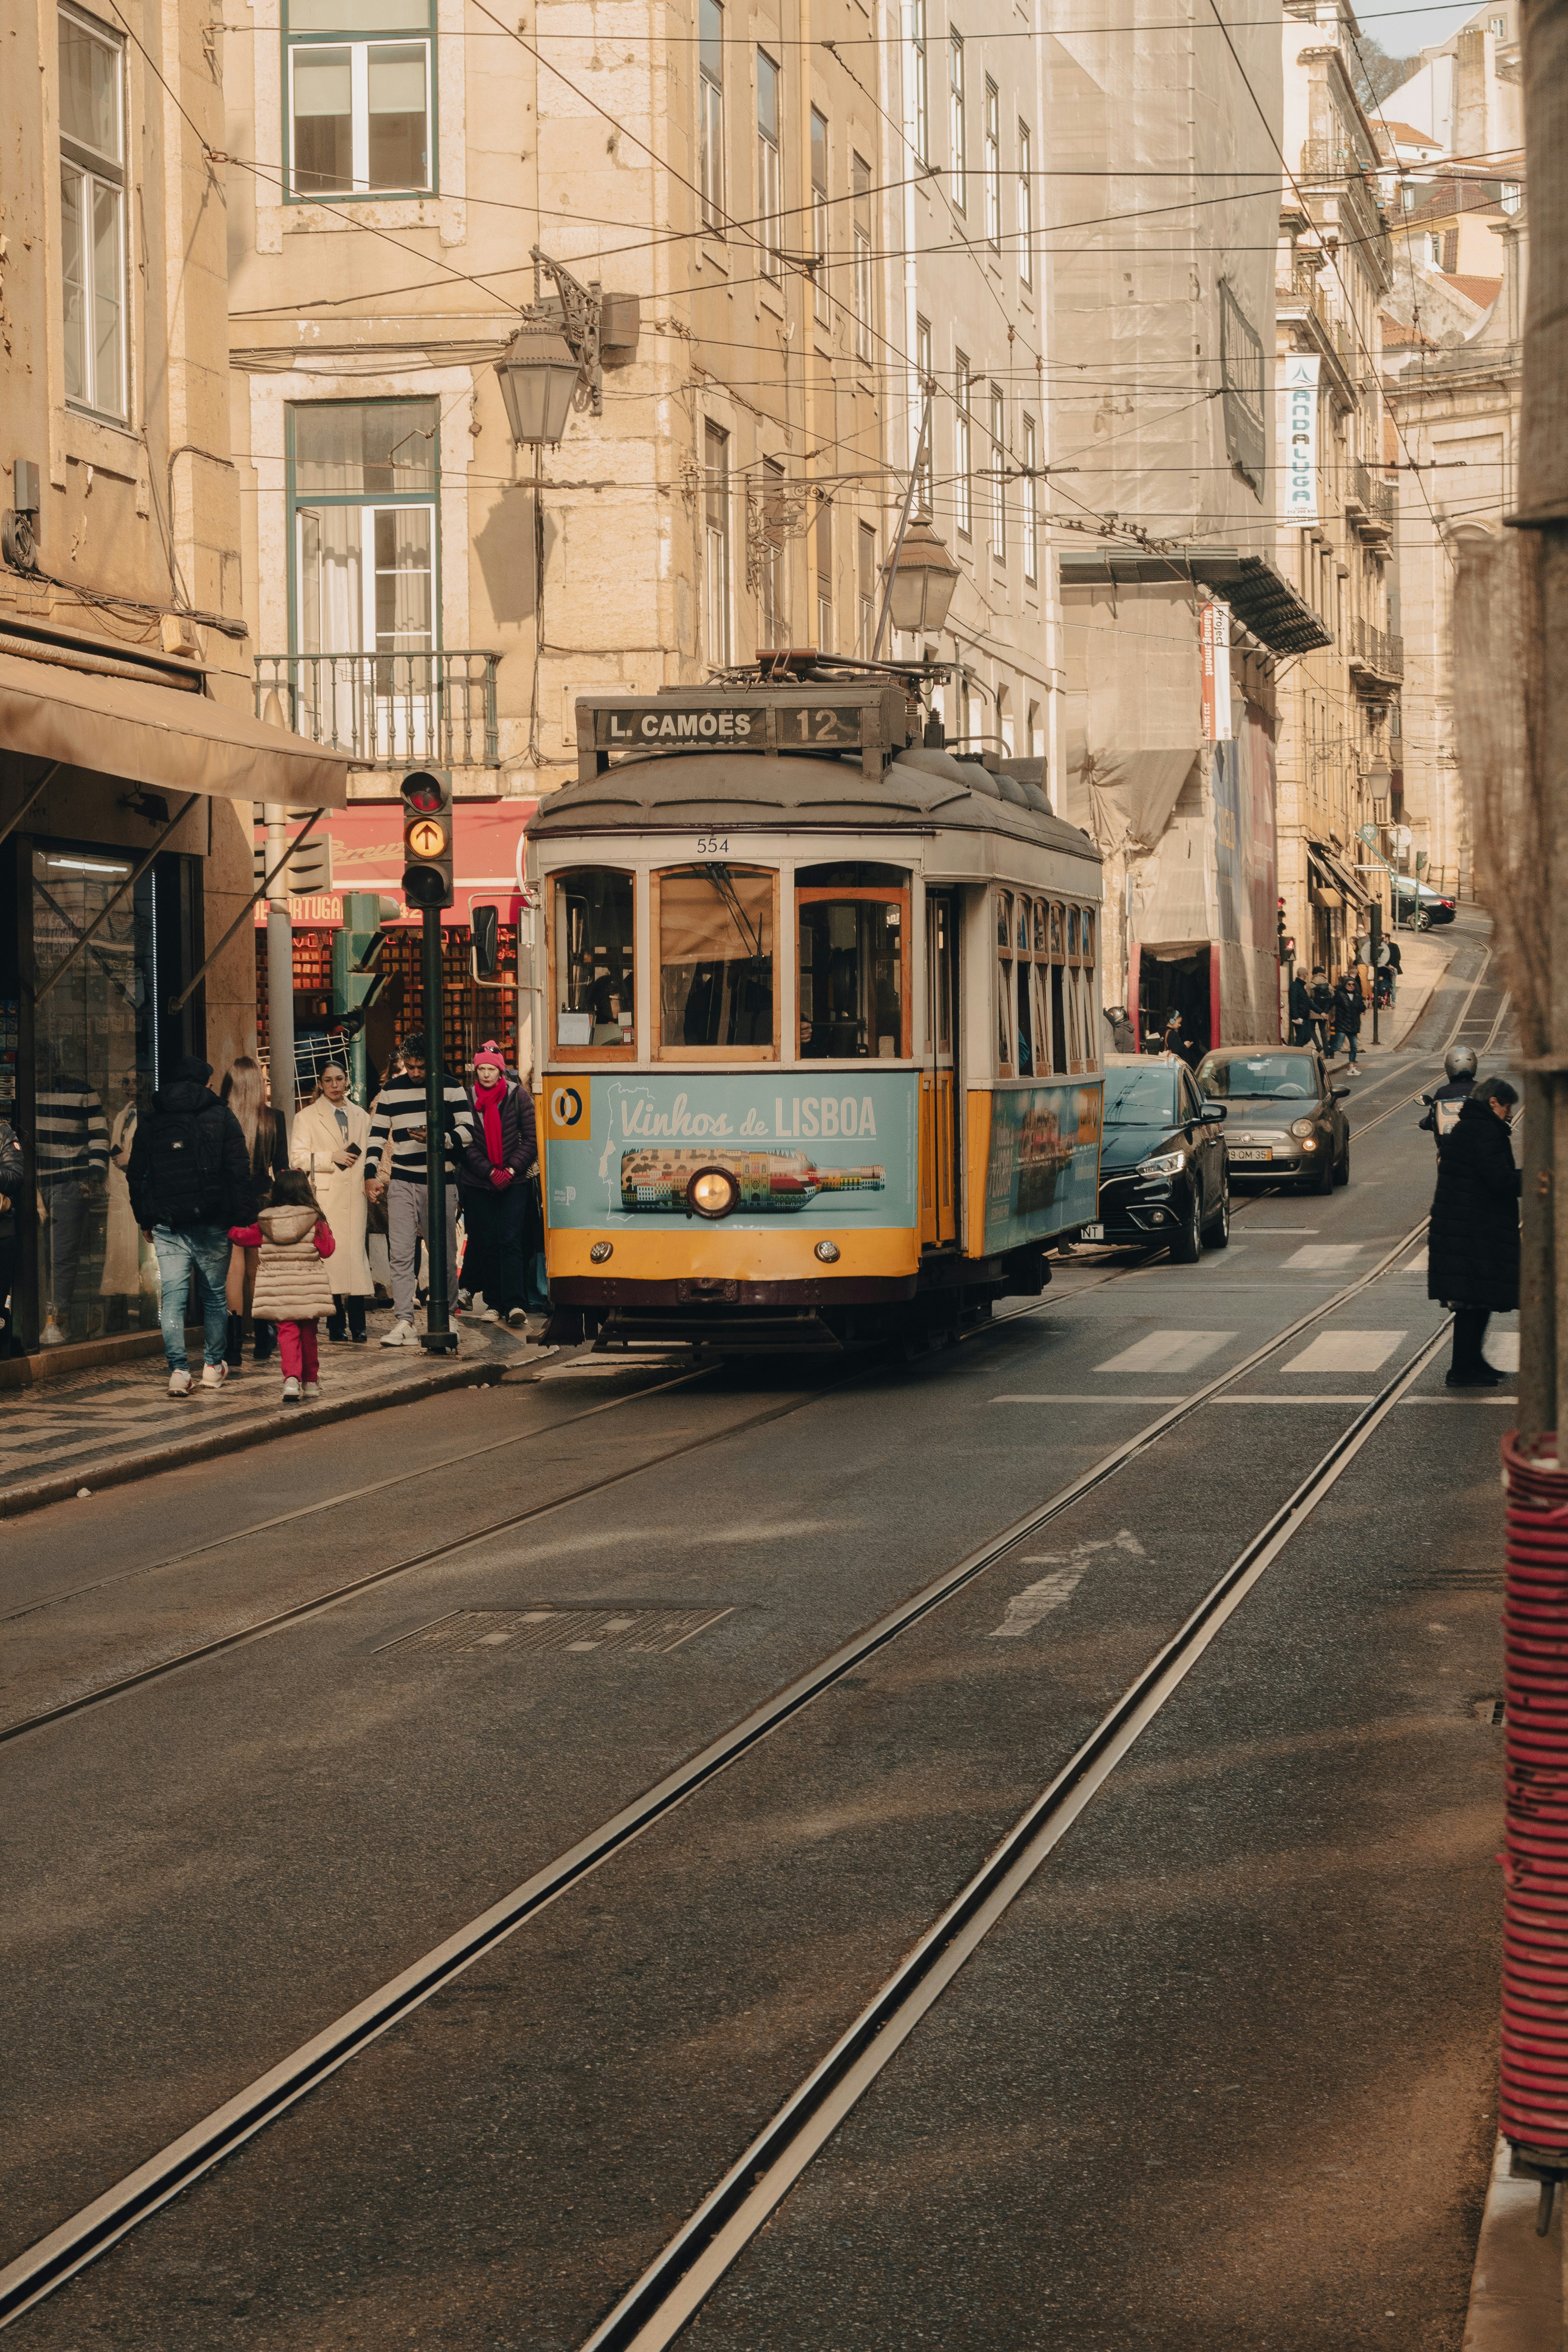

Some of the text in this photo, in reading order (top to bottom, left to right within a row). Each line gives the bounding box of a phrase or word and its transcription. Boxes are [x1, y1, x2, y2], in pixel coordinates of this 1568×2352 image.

[1202, 610, 1214, 676] Management
[1214, 610, 1225, 646] Project
[611, 715, 632, 737] L.
[797, 709, 838, 741] 12
[696, 838, 729, 853] 554
[286, 896, 343, 920] RTUGA
[621, 1093, 877, 1137] Vinhos de LISBOA
